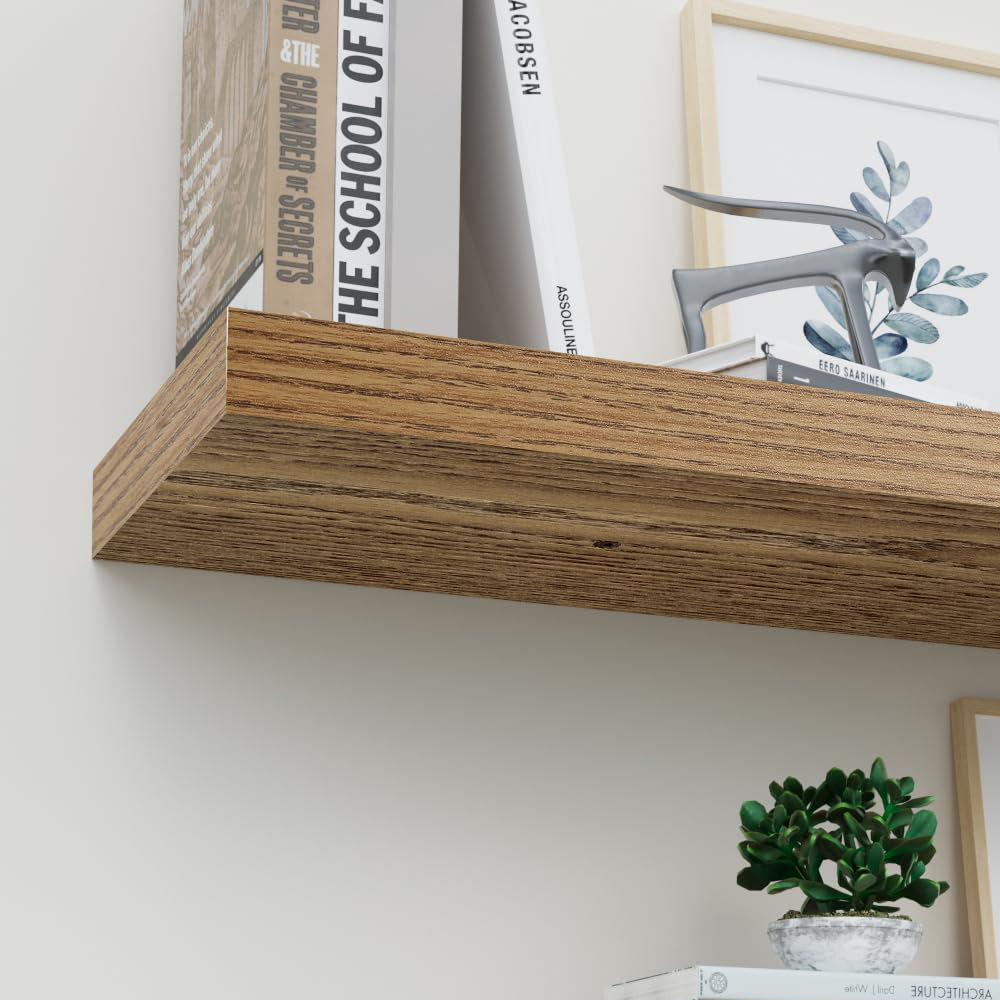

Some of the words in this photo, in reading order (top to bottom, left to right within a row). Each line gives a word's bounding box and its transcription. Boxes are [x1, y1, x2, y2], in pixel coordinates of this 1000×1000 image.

[343, 0, 384, 24] F
[341, 29, 384, 84] OF
[279, 72, 318, 174] CHAMBER
[339, 95, 383, 255] SCHOOL
[276, 194, 316, 285] SECRETS
[338, 260, 380, 323] HE
[556, 284, 579, 355] ASSOULINE
[818, 359, 841, 376] EERO
[843, 366, 887, 388] SAARINEN
